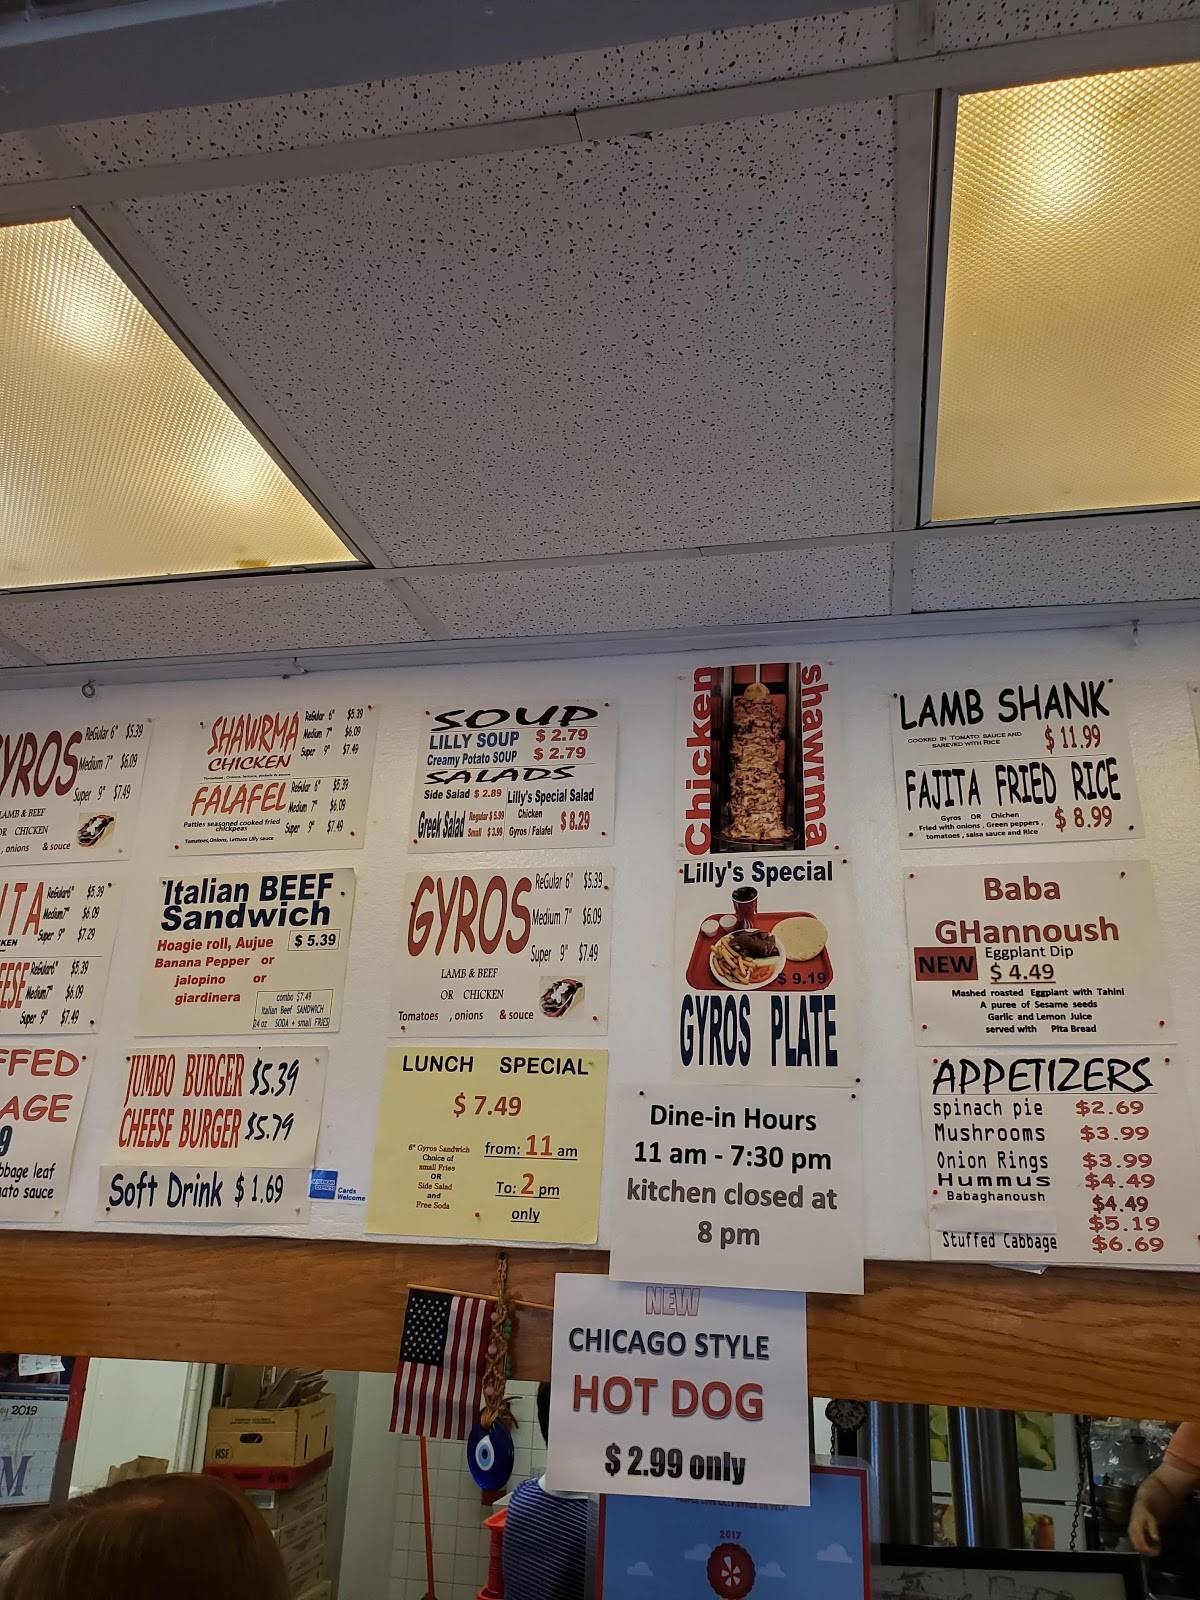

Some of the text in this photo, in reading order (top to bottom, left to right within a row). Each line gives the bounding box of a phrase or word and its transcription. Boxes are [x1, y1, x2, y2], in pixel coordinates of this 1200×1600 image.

[347, 709, 363, 719] $5.39
[900, 680, 1110, 730] LAMB SHANK
[431, 705, 598, 731] SOUP
[126, 724, 143, 738] $5.39
[207, 711, 300, 756] SHAWRMA
[303, 726, 361, 739] Medium $6.09
[429, 734, 472, 750] LILLY
[477, 731, 519, 747] SOUP
[343, 744, 359, 755] $7.49
[801, 664, 828, 848] shawrma
[0, 731, 82, 797] YROS
[79, 754, 137, 771] Medium $6.09
[208, 754, 292, 772] CHICKEN
[427, 754, 459, 768] Creamy
[462, 753, 490, 765] Potato
[493, 751, 517, 763] SOUP
[685, 666, 712, 855] Chicken
[424, 766, 575, 784] SALADS
[906, 757, 1120, 811] FAJITA FRIED RICE
[73, 785, 130, 805] Super $7.49
[191, 782, 287, 816] FALAFEL
[424, 789, 470, 799] Side Salad
[507, 788, 594, 806] Lilly's Special Salad
[288, 802, 307, 813] Medium
[518, 809, 542, 818] Chicken
[15, 826, 48, 835] CHICKEN
[327, 820, 344, 833] $7.49
[418, 811, 465, 838] Greek Salad
[509, 825, 553, 837] Gyros Falafel
[6, 842, 71, 853] onions souce
[535, 870, 603, 890] ReGular $5.39
[684, 861, 832, 887] Lilly's Special
[164, 873, 333, 905] Italian BEEF
[984, 876, 1061, 900] Baba
[161, 901, 330, 931] Sandwich
[408, 875, 532, 956] GYROS
[532, 906, 601, 926] Medium $6.09
[936, 917, 1119, 944] GHannoush
[157, 937, 273, 953] Hoagie Aujue
[986, 946, 1073, 960] Eggplant Dip
[155, 956, 275, 969] Banana Pepper or
[530, 944, 598, 967] Super $7.49
[919, 955, 975, 973] NEW
[174, 974, 267, 987] jalopino or
[441, 968, 498, 979] LAMB BEEF
[175, 992, 240, 1005] giardinera
[441, 989, 504, 1000] OR CHICKEN
[952, 989, 1024, 997] Mashed roasted
[1034, 1000, 1068, 1008] Sesame
[399, 1010, 534, 1021] Tomatoes onions souce
[1036, 1012, 1065, 1020] Lemon
[680, 994, 837, 1067] GYROS PLATE
[1071, 1024, 1096, 1033] Bread
[402, 1056, 589, 1075] LUNCH SPECIAL
[124, 1054, 299, 1107] JUMBO BURGER $5.39
[933, 1057, 1153, 1094] APPETIZERS
[651, 1104, 816, 1130] Dine-in Hours
[933, 1098, 1143, 1119] spinach pie $2.69
[118, 1108, 294, 1148] CHEESE BURGER $5.79
[935, 1124, 1149, 1142] Mushrooms $3.99
[439, 1145, 470, 1153] Sandwich
[485, 1135, 578, 1157] from: 11 am
[635, 1142, 831, 1174] 11 am 7:30 pm
[937, 1151, 1152, 1173] Onion Rings $3.99
[33, 1162, 56, 1179] leaf
[109, 1171, 157, 1208] Soft
[167, 1171, 223, 1207] Drink
[497, 1174, 560, 1198] To: 2 pm
[938, 1173, 1155, 1190] Hummus $4.49
[23, 1187, 53, 1198] sauce
[627, 1178, 837, 1209] kitchen closed at
[947, 1191, 1149, 1214] Babaghanoush $4.49
[512, 1208, 540, 1222] only
[1089, 1215, 1160, 1233] $5.19
[698, 1221, 760, 1249] 8 pm
[943, 1232, 1164, 1253] Stuffed Cabbage $6.69
[646, 1286, 700, 1316] NEW
[569, 1328, 769, 1360] CHICAGO STYLE
[573, 1375, 763, 1421] HOT DOG
[11, 1406, 37, 1415] 2019
[690, 1452, 746, 1485] only
[720, 1530, 741, 1539] 2017
